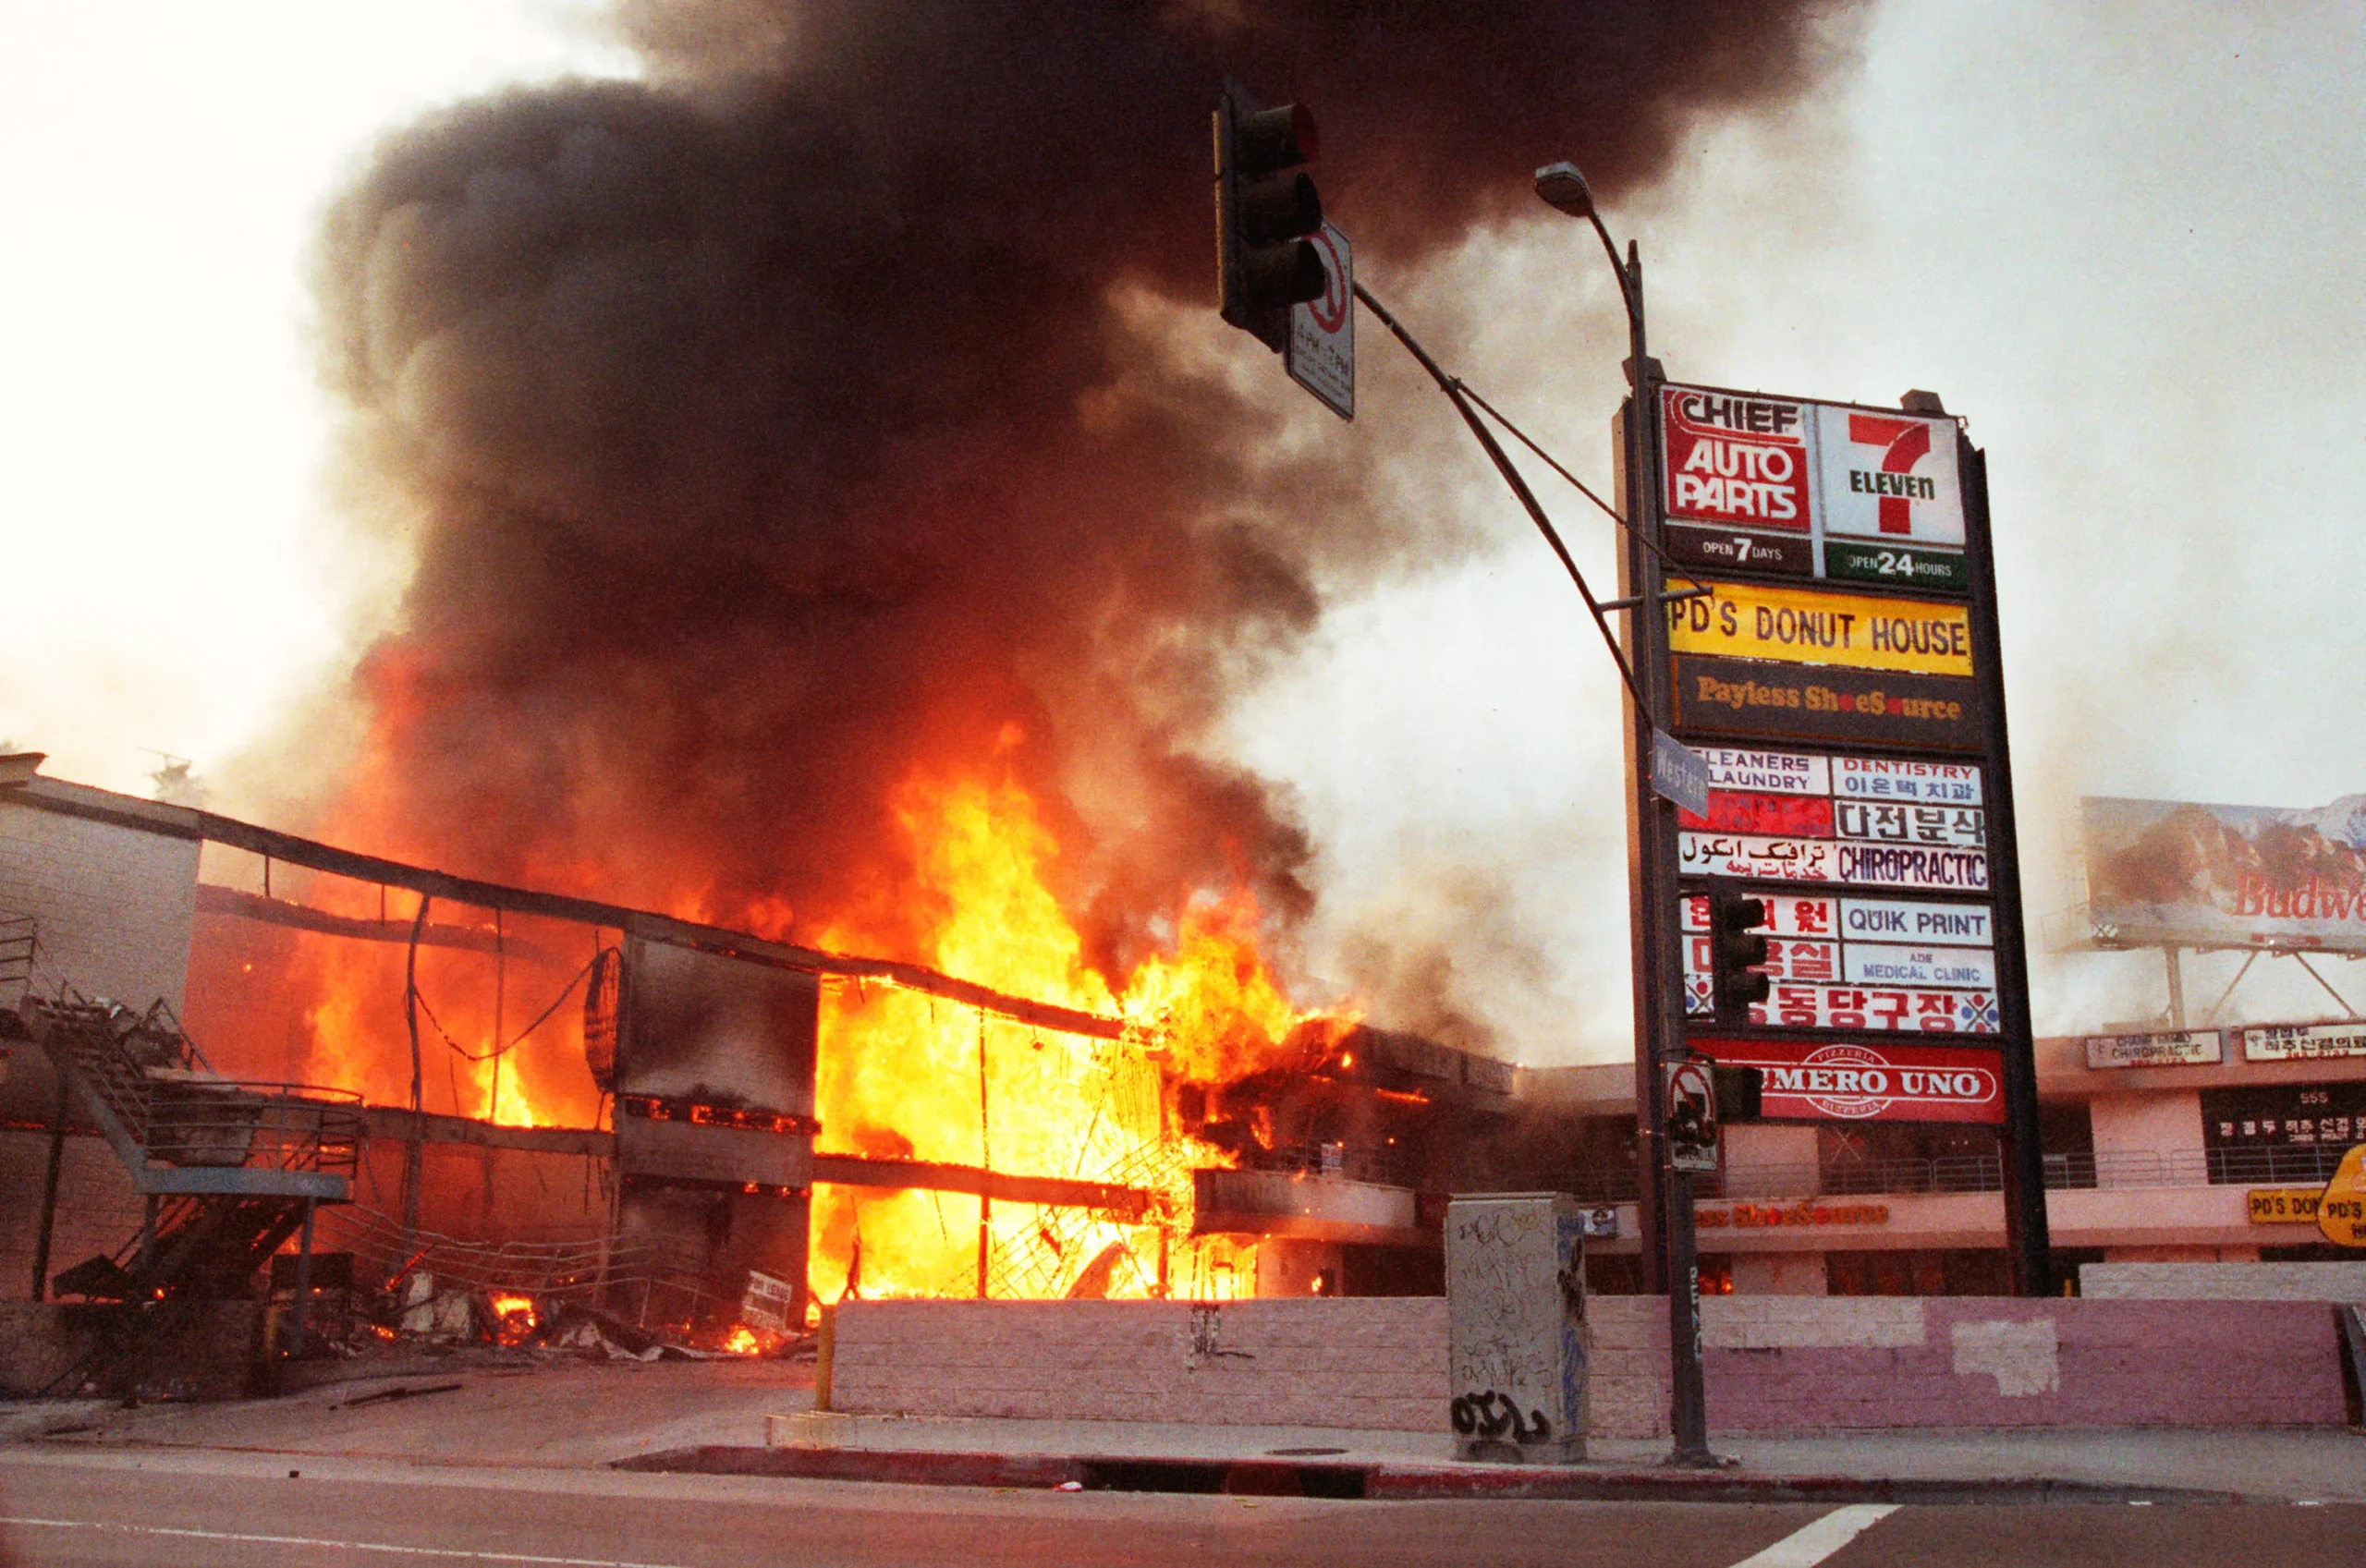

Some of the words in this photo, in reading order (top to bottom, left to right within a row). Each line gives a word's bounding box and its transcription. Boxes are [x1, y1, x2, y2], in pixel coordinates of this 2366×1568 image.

[1682, 395, 1799, 433] CHIEF
[1684, 439, 1794, 482] AUTO
[1848, 413, 1931, 534] 7
[1676, 473, 1797, 519] PARTS
[1702, 541, 1733, 556] OPEN
[1733, 538, 1752, 562] 7
[1752, 547, 1783, 561] DAYS
[1878, 553, 1914, 577] 24
[1915, 562, 1952, 577] HOURS
[1670, 598, 1738, 637] PD'S
[1756, 605, 1856, 649] DONUT
[1872, 616, 1968, 656] HOUSE
[1696, 675, 1799, 710] Payless
[1693, 749, 1810, 772] LEANERS
[1843, 758, 1974, 780] DENTISTRY
[1709, 768, 1810, 790] LAUNDRY
[1838, 845, 1986, 887] CHIROPRACTIC
[1849, 908, 1908, 932] QUIK
[1917, 912, 1986, 936] PRINT
[1863, 964, 1927, 980] MEDICAL
[1933, 967, 1981, 982] CLINIC
[1818, 1048, 1875, 1064] PIZZERIA
[1900, 1072, 1981, 1096] UNO
